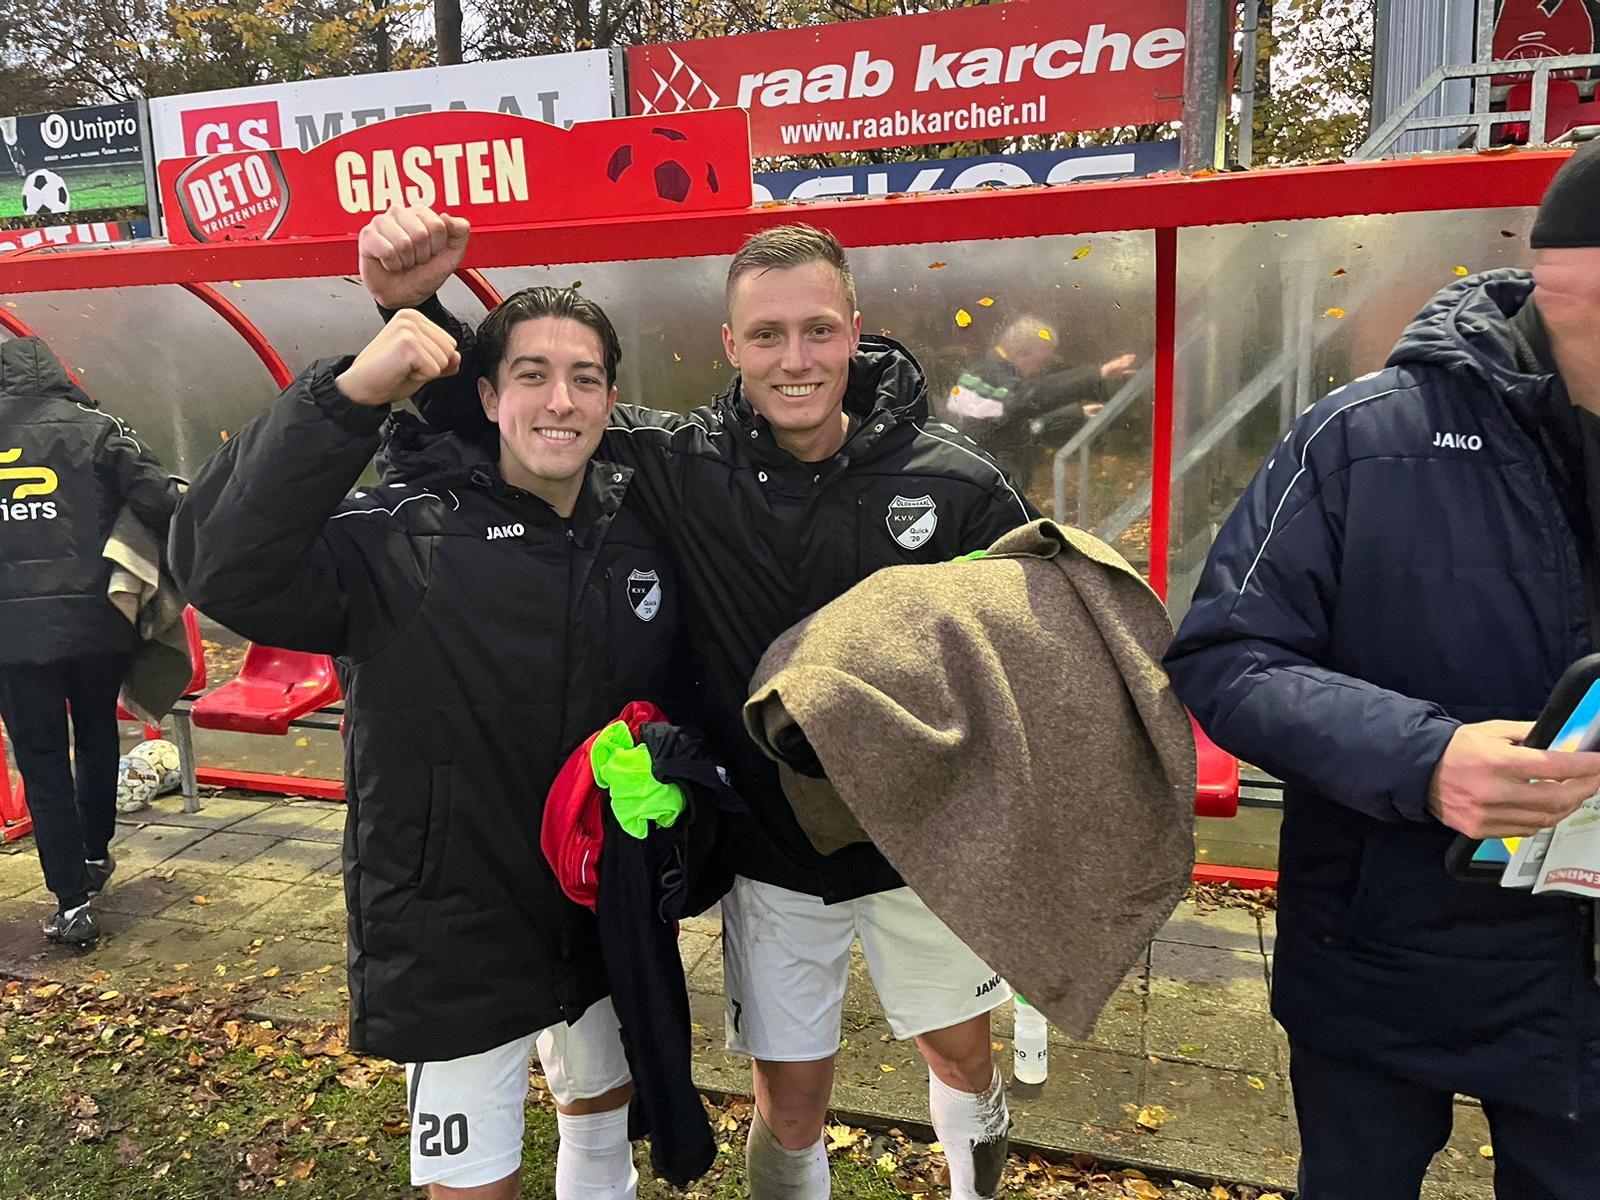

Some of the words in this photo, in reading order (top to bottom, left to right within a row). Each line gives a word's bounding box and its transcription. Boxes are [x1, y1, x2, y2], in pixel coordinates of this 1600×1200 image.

[736, 50, 894, 109] raab
[70, 117, 137, 144] Unipro
[780, 95, 1047, 145] www.raabkarcher.nl
[188, 154, 273, 222] DETO
[333, 136, 530, 215] GASTEN
[202, 197, 280, 236] VRIEZENVEEN
[1432, 432, 1483, 451] JAKO
[486, 523, 525, 540] JAKO
[418, 1112, 469, 1157] 20
